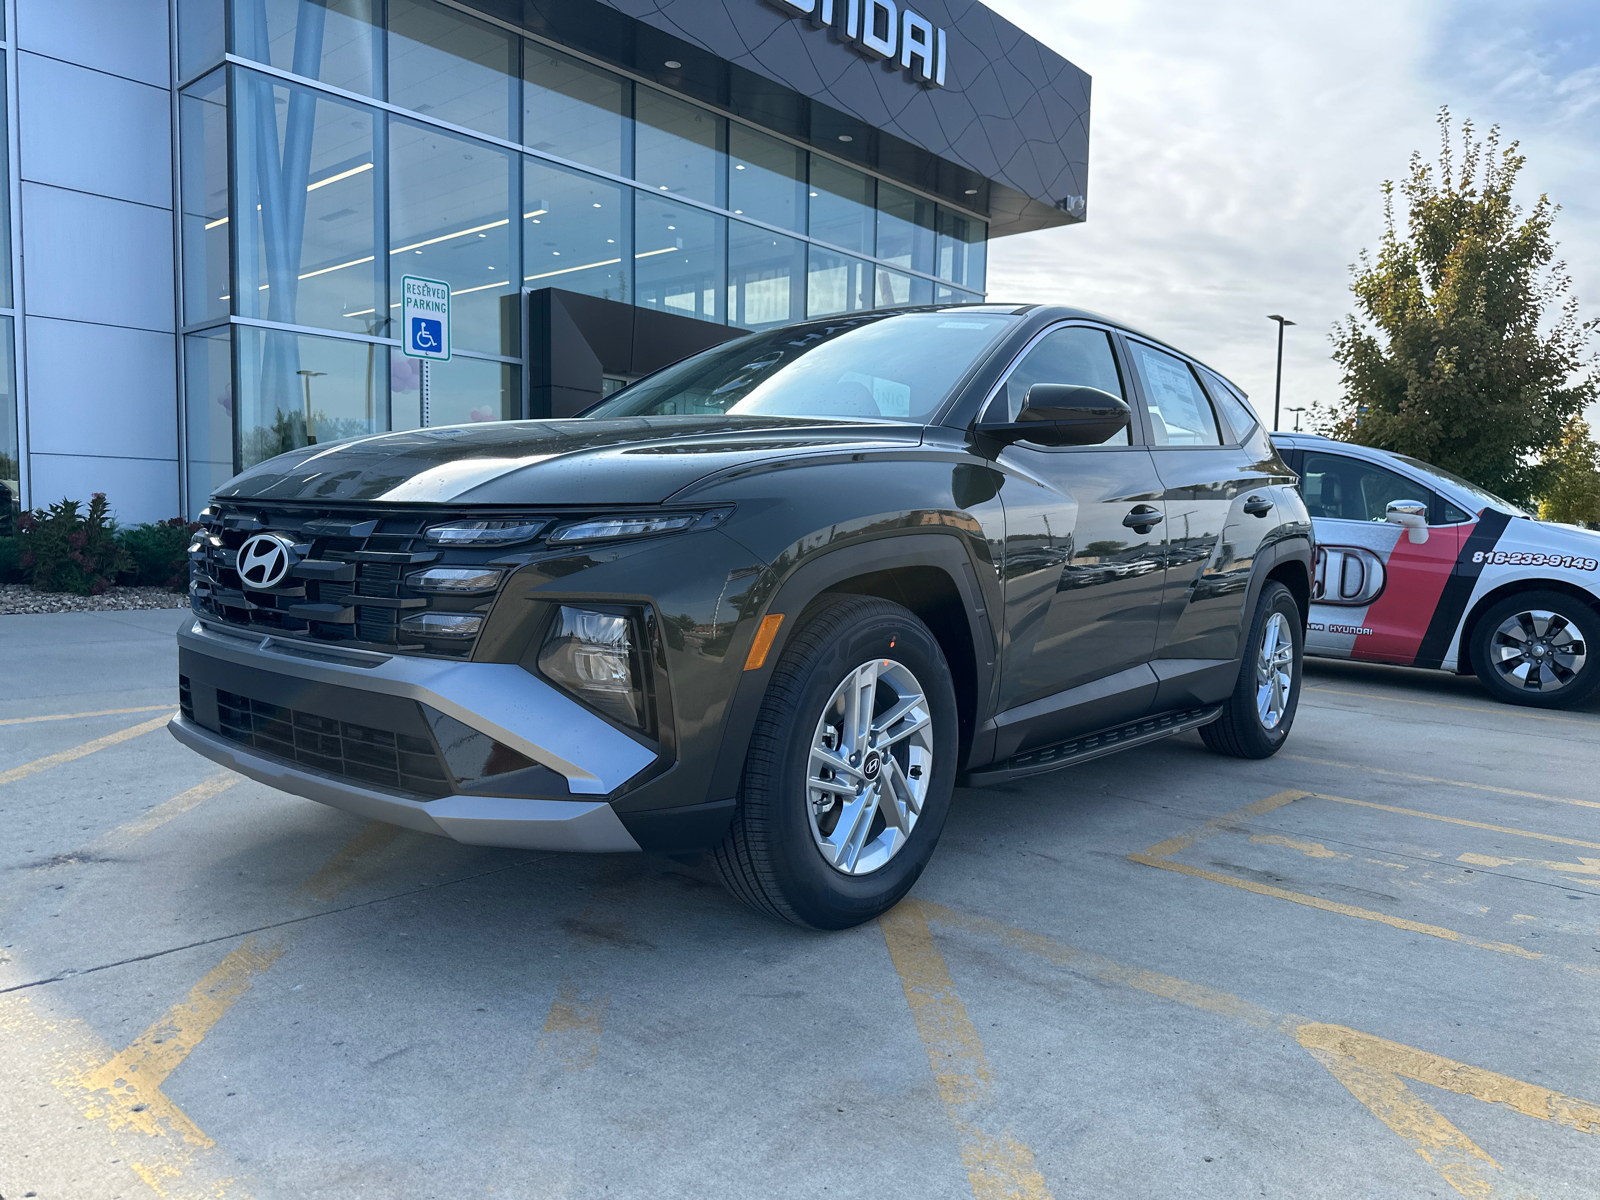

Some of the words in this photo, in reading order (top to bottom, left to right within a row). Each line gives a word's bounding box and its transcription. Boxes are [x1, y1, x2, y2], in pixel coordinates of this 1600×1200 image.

[784, 0, 947, 86] NDAI
[406, 283, 445, 299] RESERVED
[406, 297, 446, 313] PARKING
[1472, 550, 1598, 571] 816-233-9149
[1329, 624, 1373, 636] HYUNDAI
